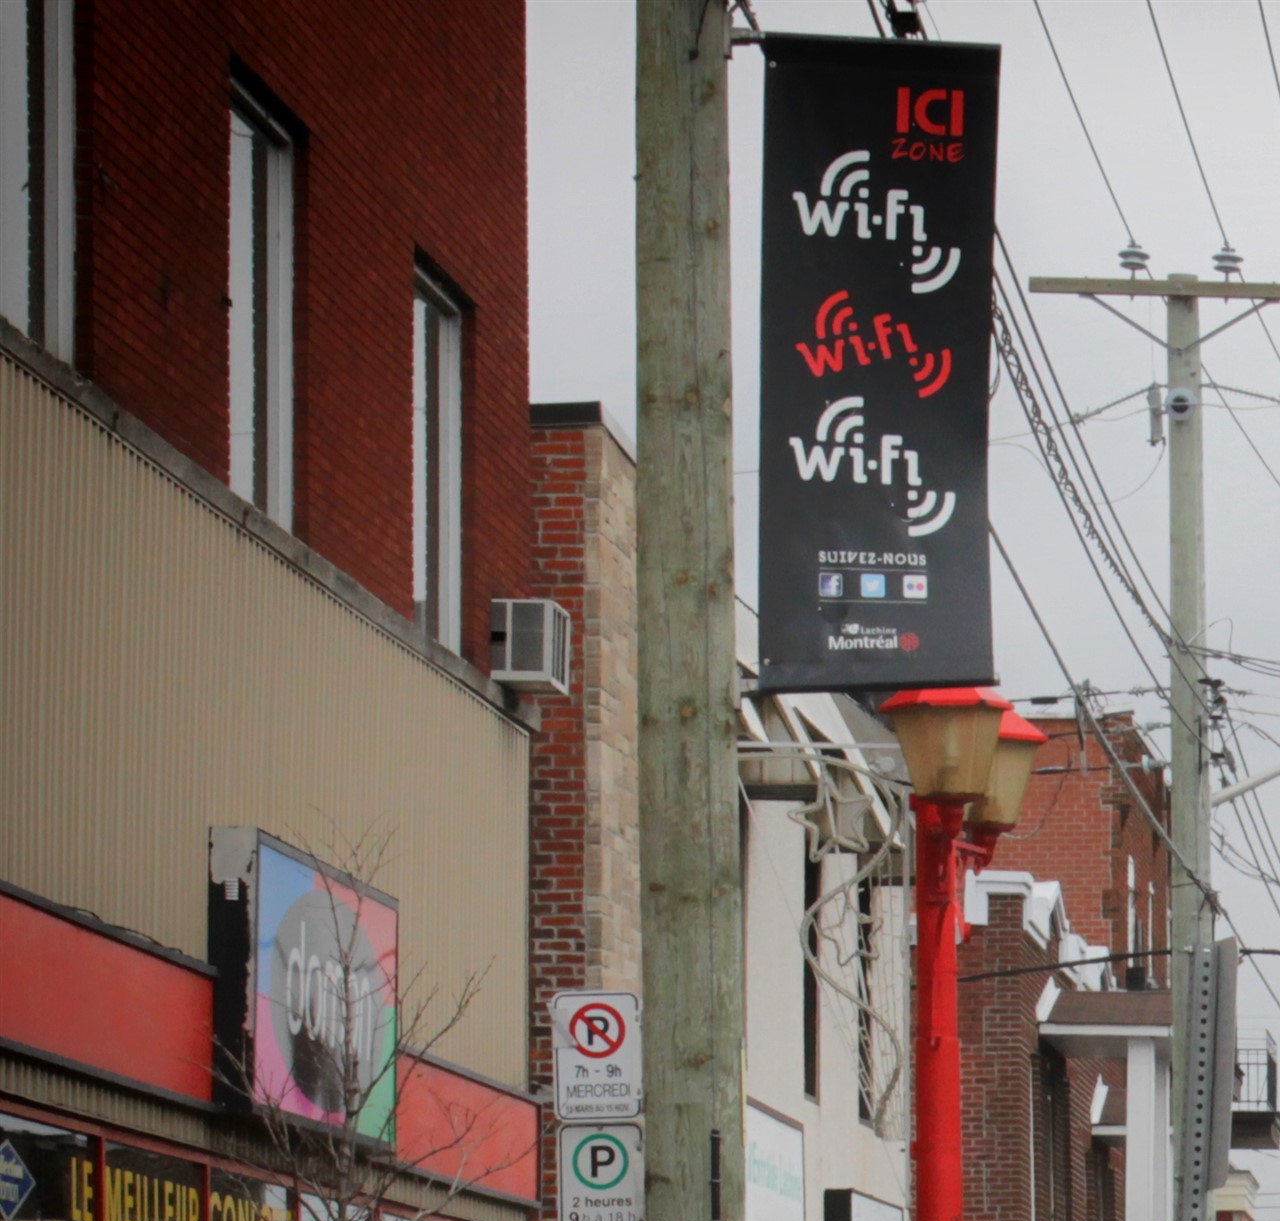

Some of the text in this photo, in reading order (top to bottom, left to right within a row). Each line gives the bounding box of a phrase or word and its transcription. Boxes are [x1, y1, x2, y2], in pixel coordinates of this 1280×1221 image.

[896, 86, 964, 136] ICI
[891, 138, 964, 162] ZONE
[818, 550, 927, 566] SUIVEZ-NOUS
[828, 634, 898, 650] Montréal
[574, 1065, 588, 1079] 7h
[606, 1064, 621, 1078] 9h
[566, 1083, 631, 1098] MERCREDI
[573, 1196, 632, 1208] 2 heures
